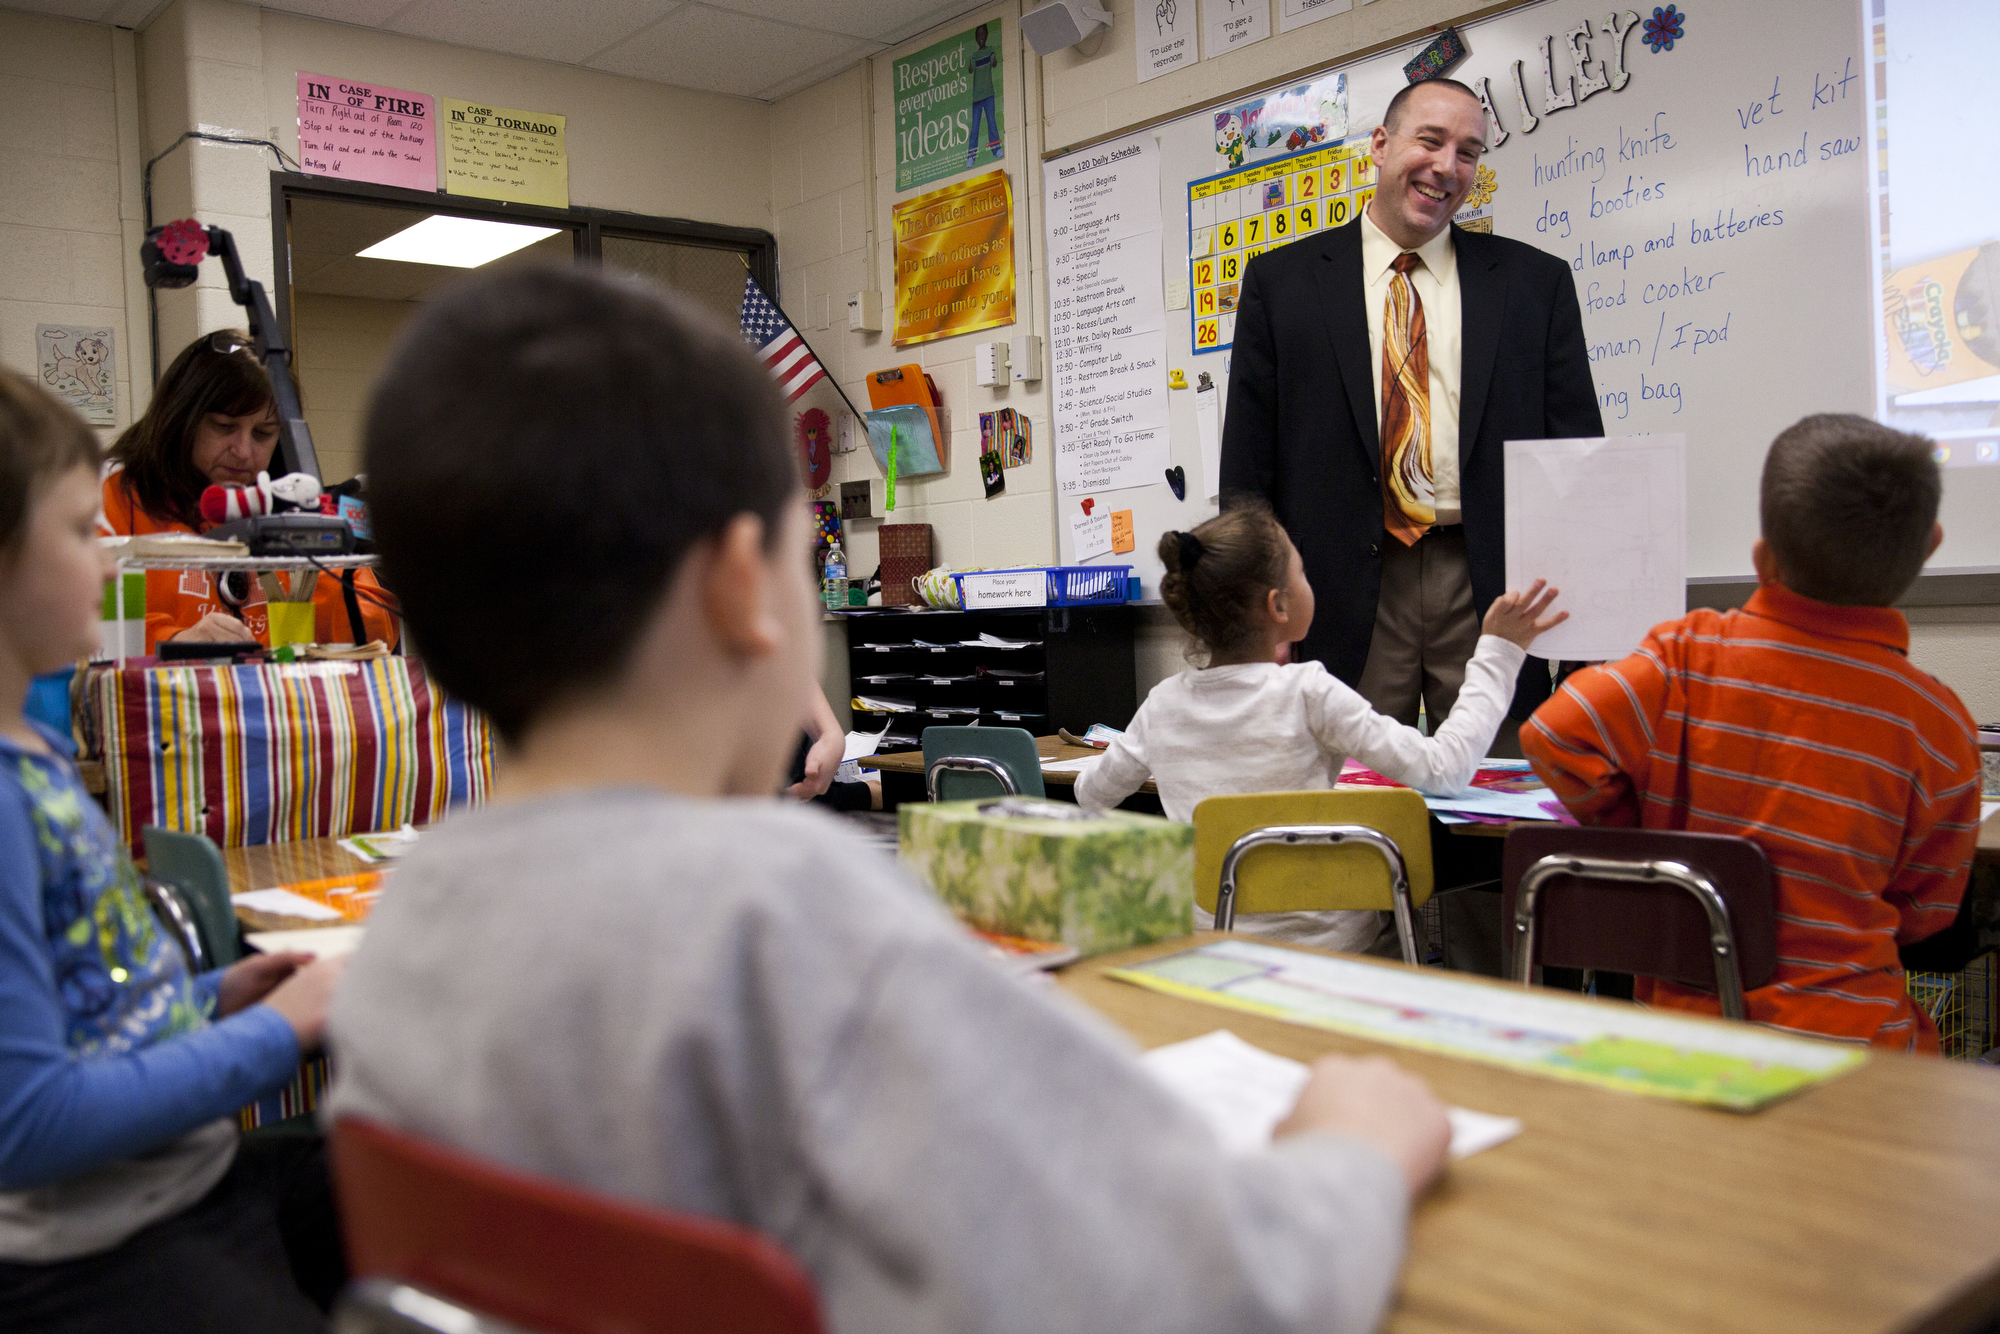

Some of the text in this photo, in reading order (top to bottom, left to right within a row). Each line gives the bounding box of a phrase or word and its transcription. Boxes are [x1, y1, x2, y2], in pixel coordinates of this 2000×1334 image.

[1223, 22, 1234, 33] To
[1235, 17, 1247, 29] get
[1229, 29, 1248, 43] drink
[1150, 38, 1185, 59] To use the
[898, 42, 966, 92] Respect
[1153, 52, 1183, 69] restroom
[307, 82, 425, 117] IN CASE OF FIRE
[899, 73, 968, 115] everyone's
[1737, 56, 1859, 130] vet kit
[302, 100, 423, 131] Turn Right out Room 120
[451, 106, 557, 136] IN CASE OF TORNADO
[1240, 94, 1320, 131] January
[303, 119, 322, 133] Stop
[338, 124, 350, 133] the
[381, 130, 394, 140] the
[900, 108, 970, 164] ideas
[304, 140, 398, 159] Turn left and exit into the
[1295, 154, 1317, 164] Thursday
[1327, 148, 1343, 157] Friday
[1533, 111, 1678, 187] hunting knife
[1744, 131, 1861, 177] hand saw
[1058, 144, 1141, 177] Room 120 Daily Schedule
[1265, 161, 1292, 172] Wednesday
[1358, 160, 1369, 181] 4
[1218, 177, 1236, 186] Monday
[1243, 169, 1262, 179] Tuesday
[1330, 168, 1340, 190] 3
[1053, 174, 1117, 200] 8:35 School Begins
[1195, 184, 1211, 193] Sunday
[1303, 175, 1314, 197] 2
[900, 192, 1005, 236] The Golden Rule:
[1329, 201, 1346, 224] 10
[1536, 175, 1666, 238] dog booties
[1053, 212, 1121, 238] 9:00 Language Arts
[1276, 213, 1286, 234] 8
[1300, 208, 1312, 228] 9
[1224, 226, 1234, 246] 6
[1249, 220, 1259, 241] 7
[1591, 240, 1635, 271] lamp
[1643, 222, 1676, 253] and
[1690, 204, 1784, 244] batteries
[903, 236, 1006, 274] Do unto others as
[1055, 242, 1122, 266] 9:30 Language Arts
[1056, 268, 1099, 287] 9:45 Special
[1197, 264, 1211, 285] 12
[1223, 258, 1237, 279] 13
[907, 264, 1001, 302] you would have
[1586, 265, 1726, 314] food cooker
[901, 289, 1009, 325] them do unto you.
[1053, 284, 1126, 310] 10:35 Restroom Break
[1200, 291, 1214, 313] 19
[1053, 296, 1136, 322] 10:50 Language Arts cont
[1053, 313, 1118, 335] 11:30 Recess/Lunch
[1925, 282, 1952, 362] Crayola
[1054, 324, 1132, 349] 12:10 Mrs. Dailey Reads
[1198, 323, 1217, 344] 26
[1056, 343, 1102, 360] 12:30 Writing
[1056, 351, 1123, 373] 12:50 Computer Lab
[1060, 357, 1157, 386] 1:15 Restroom Break Snack
[1058, 387, 1153, 412] 2:45 Science/Social Studies
[1060, 384, 1097, 399] 1:40 Math
[1640, 373, 1683, 415] bag
[1060, 423, 1074, 434] 2:50
[1089, 418, 1110, 429] Grade
[1110, 412, 1134, 425] Switch
[1061, 431, 1155, 454] 3:20 Get Ready To Go Home
[1062, 476, 1111, 491] 3:35 Dismissal
[992, 578, 1005, 586] Place
[977, 588, 1032, 599] homework here
